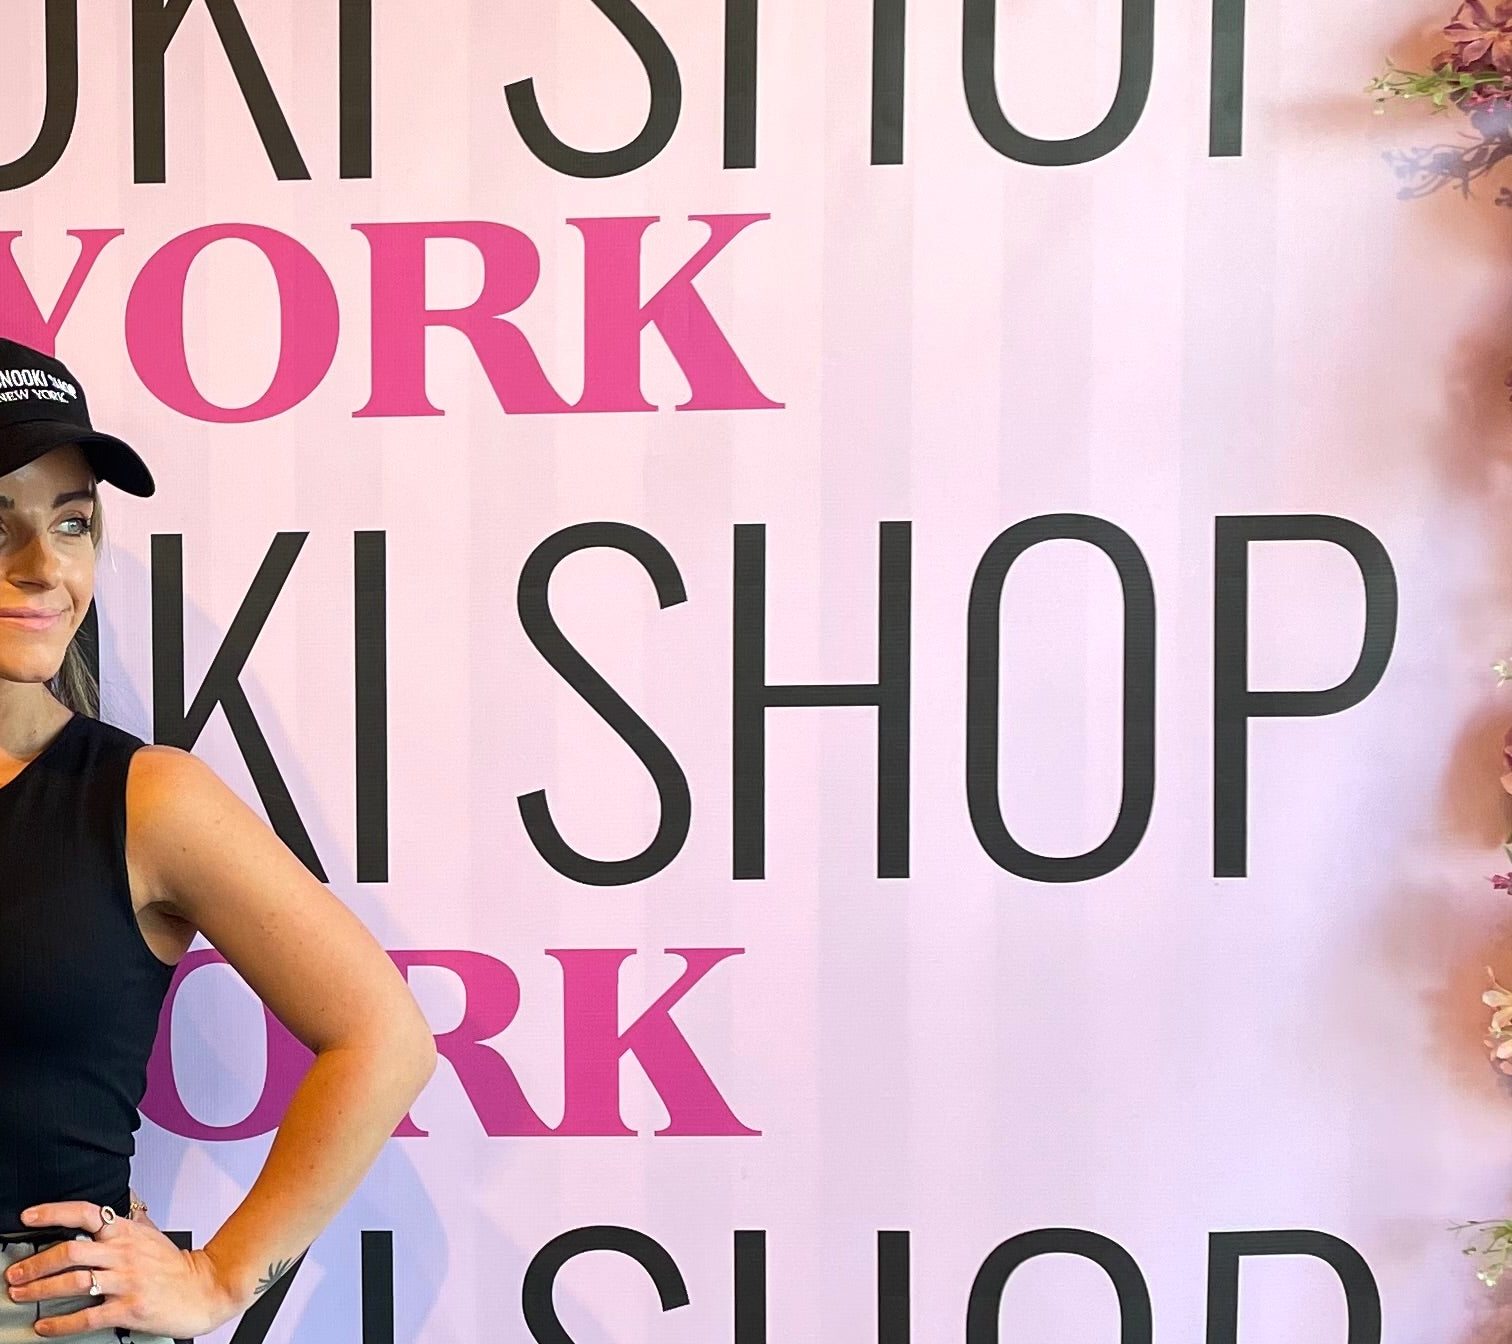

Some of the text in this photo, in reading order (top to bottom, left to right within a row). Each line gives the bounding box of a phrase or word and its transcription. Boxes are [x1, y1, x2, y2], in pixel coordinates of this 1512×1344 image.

[31, 388, 70, 404] YORK
[516, 513, 1398, 887] SHOP
[139, 947, 761, 1142] ORK
